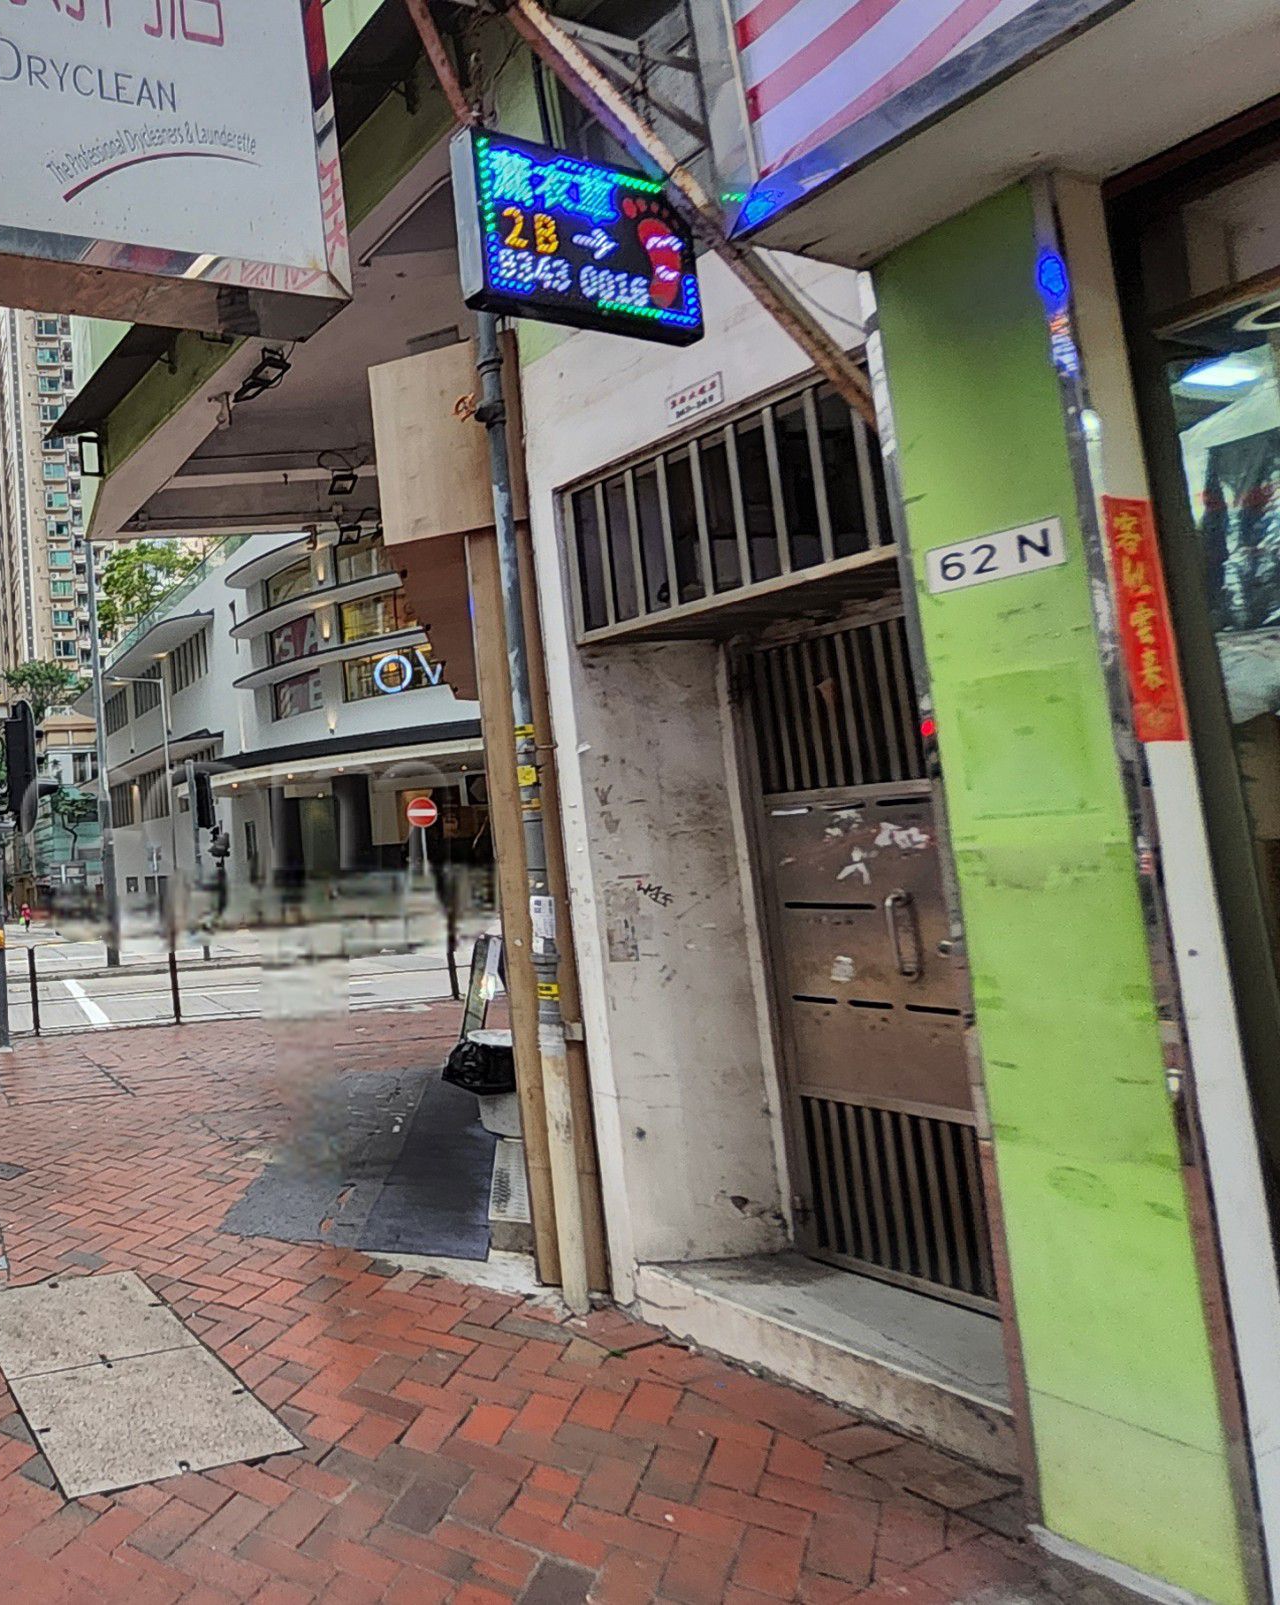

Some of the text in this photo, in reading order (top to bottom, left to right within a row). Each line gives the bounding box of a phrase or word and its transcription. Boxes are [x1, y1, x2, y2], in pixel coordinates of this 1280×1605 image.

[46, 121, 257, 184] The Professional Drycleaners & Launderette
[940, 528, 1052, 581] 62 N
